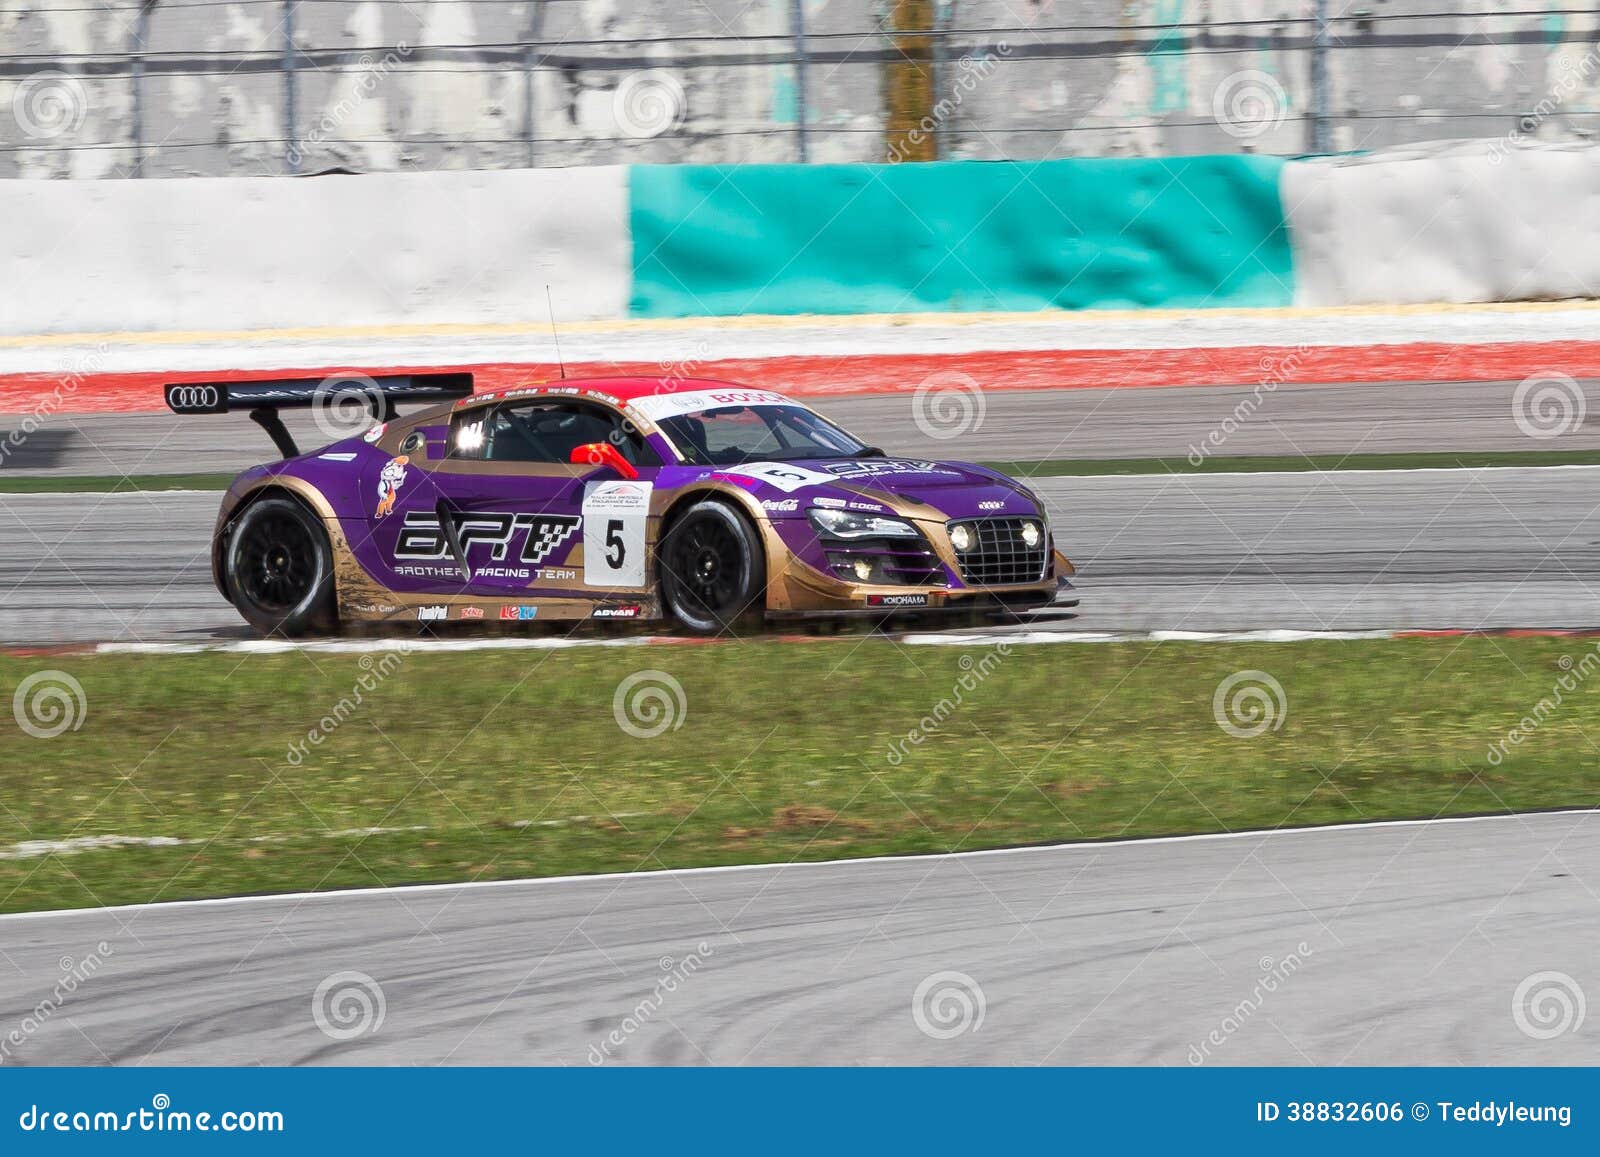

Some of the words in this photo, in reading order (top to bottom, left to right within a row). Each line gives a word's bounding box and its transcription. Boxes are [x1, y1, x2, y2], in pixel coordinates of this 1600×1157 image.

[850, 502, 883, 511] EDGE
[605, 519, 626, 570] 5
[474, 567, 530, 579] RACING
[535, 568, 576, 580] TEAM
[882, 596, 926, 605] YOKOHAMA
